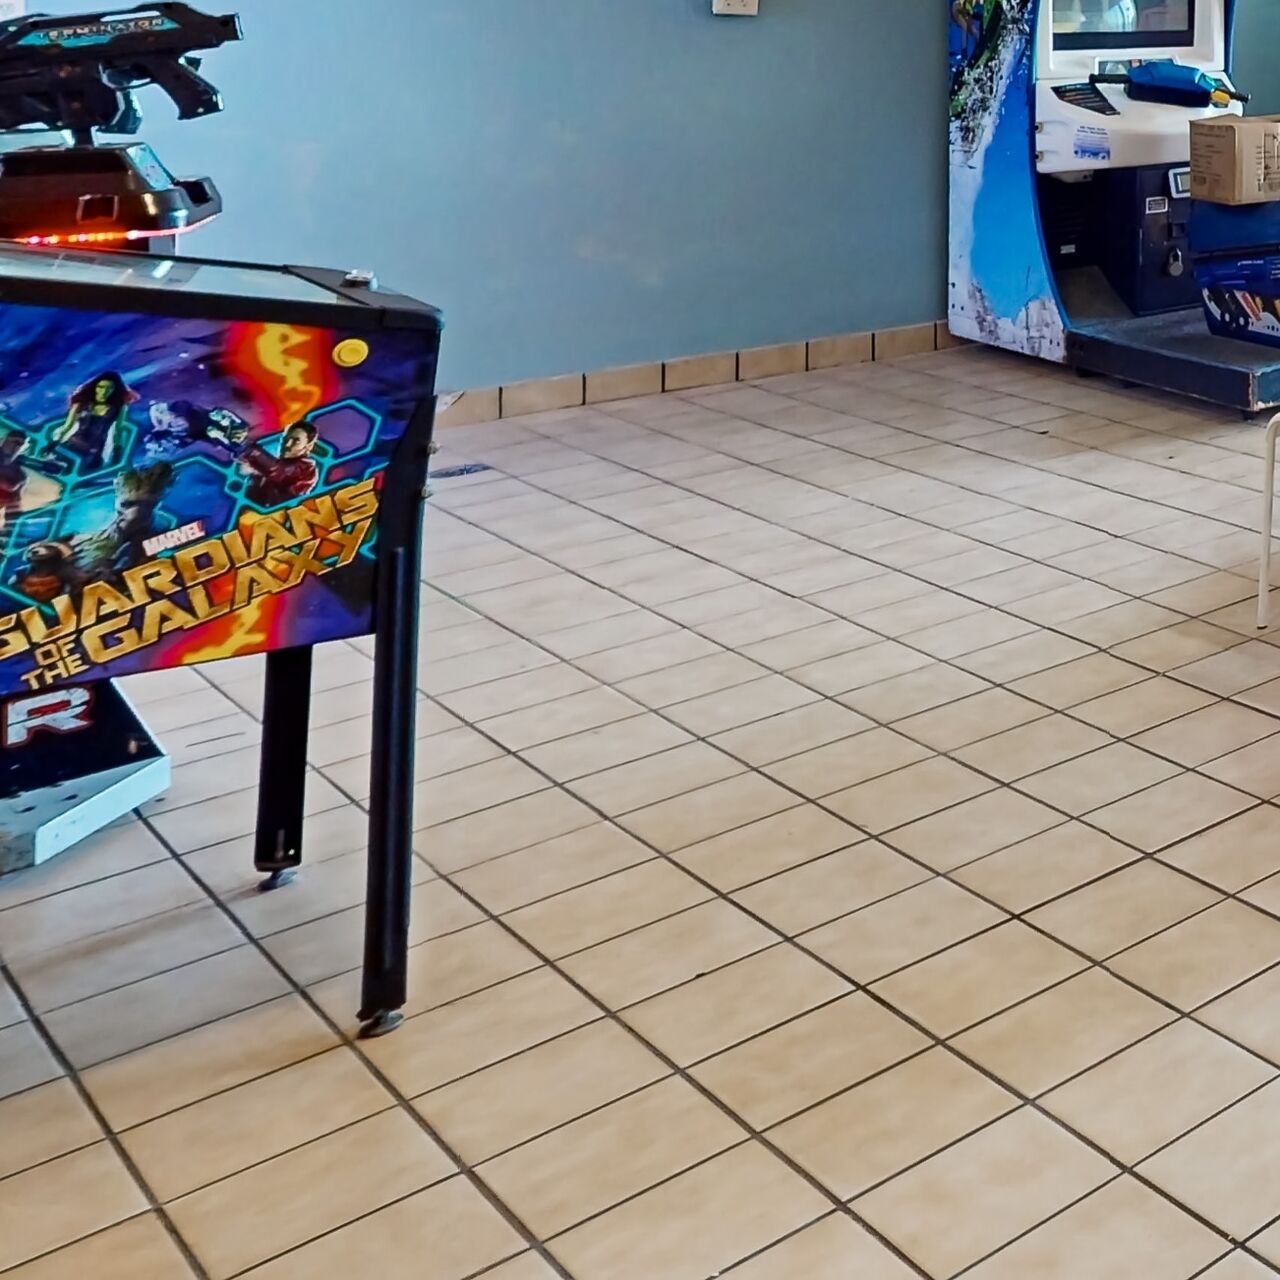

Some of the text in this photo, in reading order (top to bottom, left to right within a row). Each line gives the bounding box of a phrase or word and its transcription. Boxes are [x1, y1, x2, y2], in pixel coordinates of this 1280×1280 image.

[143, 521, 206, 556] MARVEL
[0, 478, 380, 661] GUARDIANS
[79, 517, 374, 665] GALAXY
[34, 633, 80, 667] OF
[20, 653, 92, 691] THE
